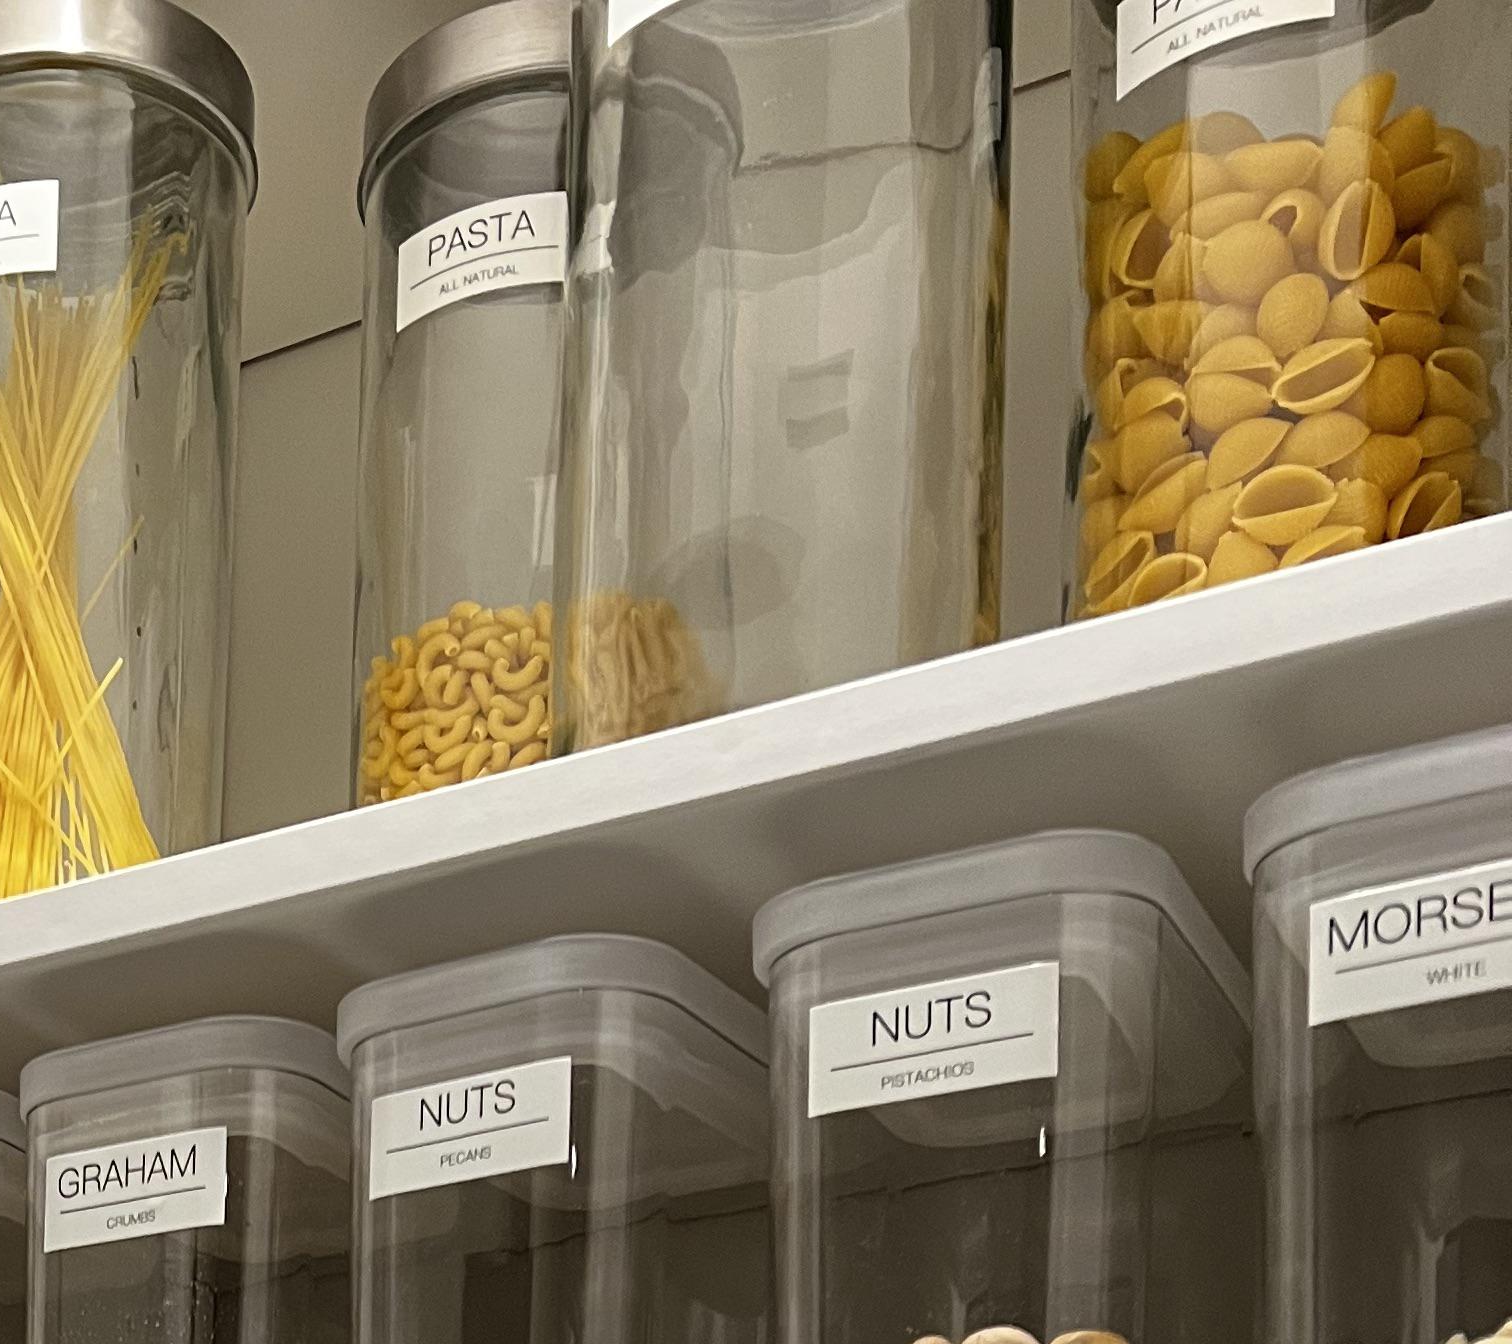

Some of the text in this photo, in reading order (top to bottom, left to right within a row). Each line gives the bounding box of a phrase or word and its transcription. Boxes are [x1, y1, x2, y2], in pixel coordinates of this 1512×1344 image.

[1196, 6, 1264, 40] NATURAL
[428, 210, 535, 267] PASTA
[438, 264, 520, 295] ALL NATURAL
[1426, 959, 1487, 985] WHITE
[871, 990, 992, 1048] NUTS
[880, 1061, 975, 1090] PISTACHIOS
[419, 1078, 516, 1131] NUTS
[57, 1144, 197, 1199] GRAHAM
[440, 1146, 492, 1168] PECANS
[105, 1209, 156, 1230] CRUMBS
